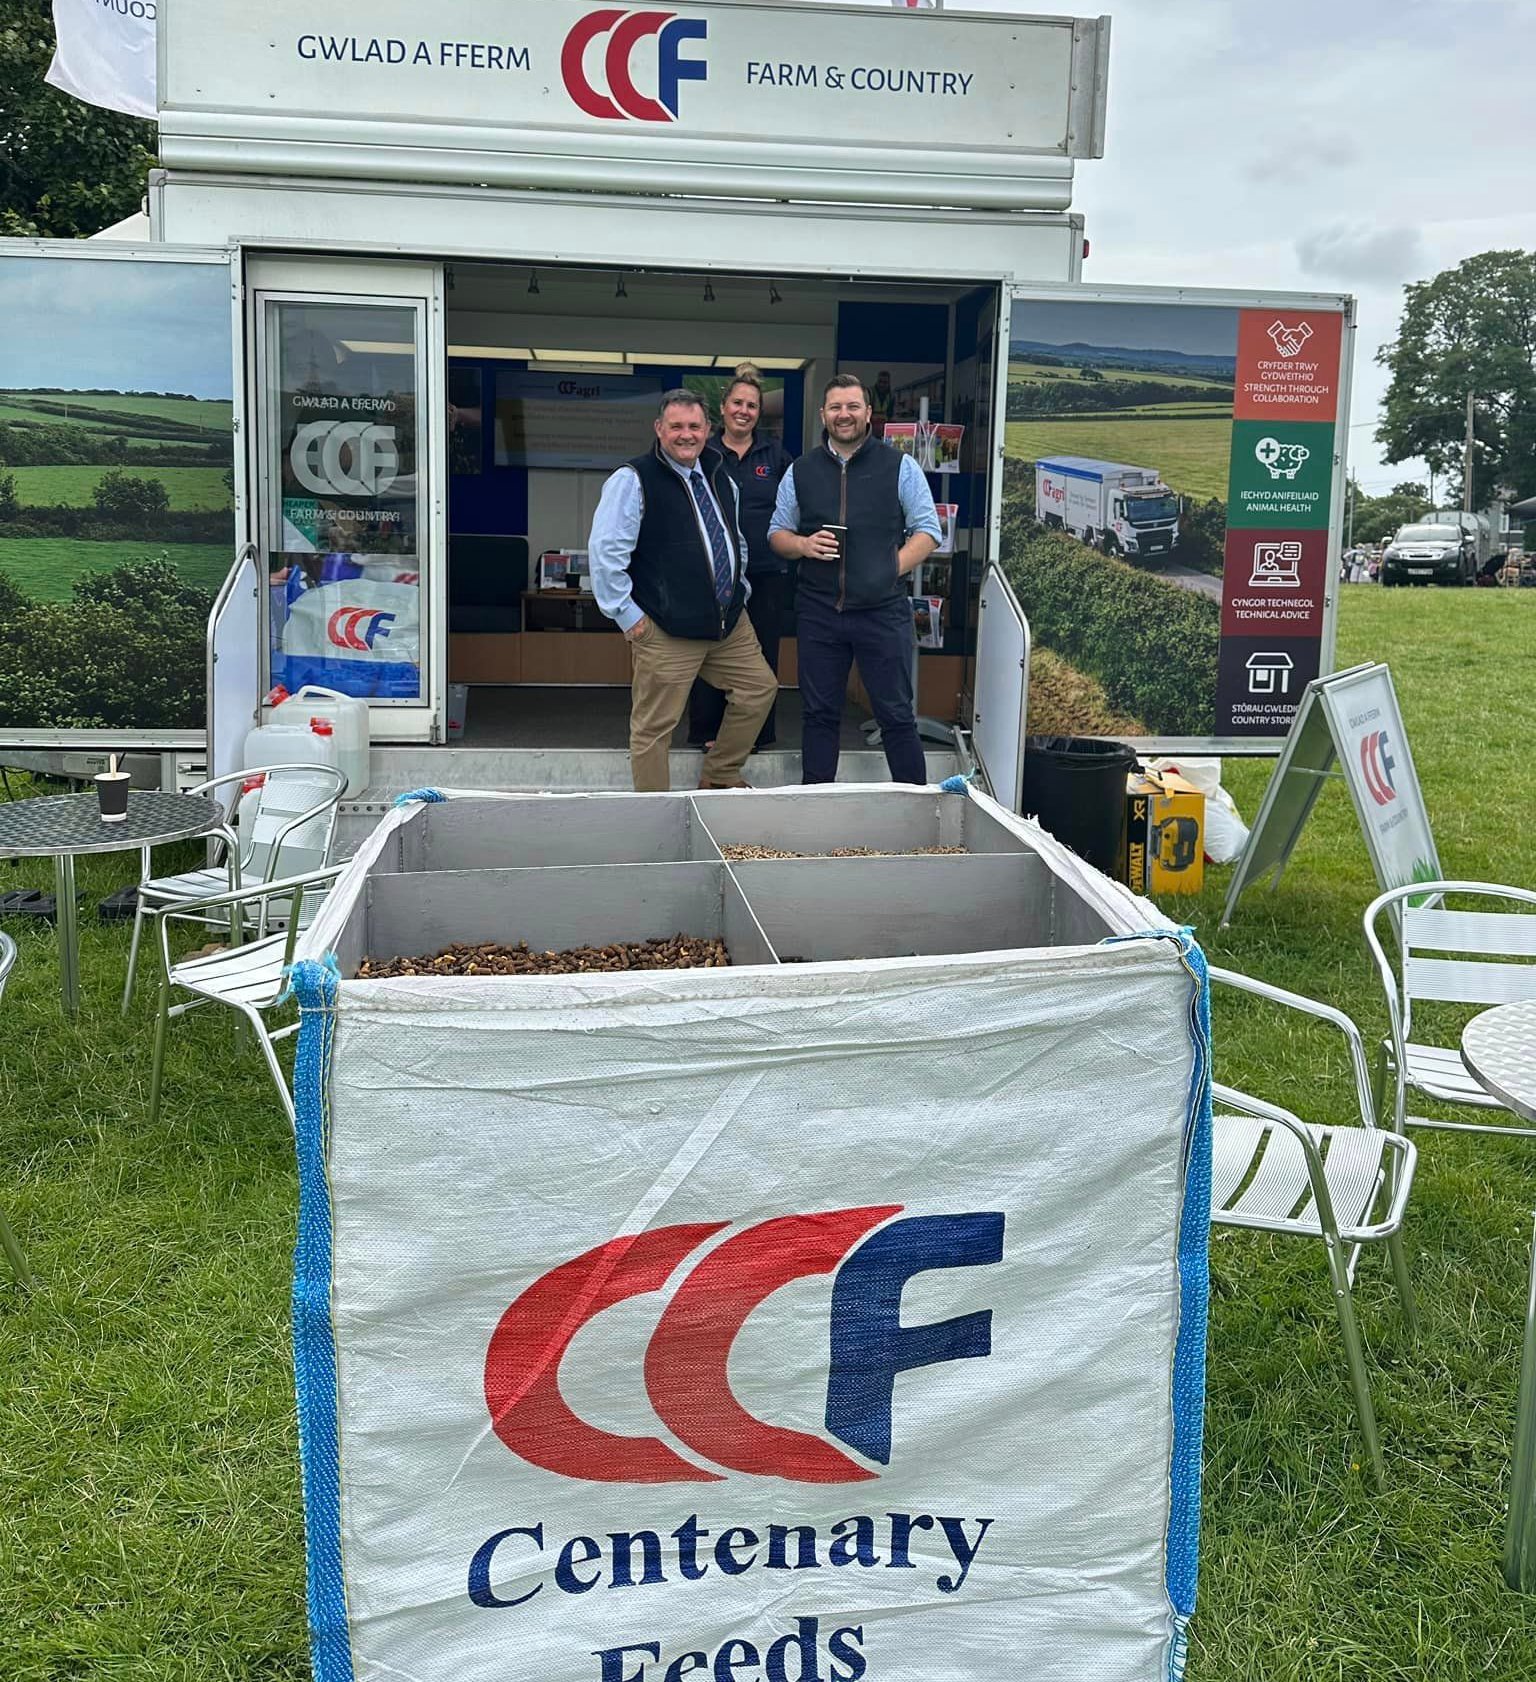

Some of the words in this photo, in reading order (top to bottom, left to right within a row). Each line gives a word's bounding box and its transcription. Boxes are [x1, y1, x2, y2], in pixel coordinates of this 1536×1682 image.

[297, 35, 406, 64] GWLAD
[412, 41, 432, 65] A
[440, 42, 531, 71] FFERM
[560, 9, 708, 122] CCF
[746, 62, 817, 88] FARM
[825, 65, 845, 90] &
[851, 67, 974, 96] COUNTRY
[1257, 361, 1294, 370] CRYFDER
[1295, 362, 1319, 371] TRWY
[1261, 371, 1314, 381] GYDWEITHIO
[1243, 383, 1286, 392] STRENGTH
[1288, 384, 1329, 394] THROUGH
[1253, 393, 1319, 404] COLLABORATION
[1240, 490, 1271, 500] IECHYD
[1246, 503, 1279, 512] ANIMAL
[1280, 503, 1312, 512] HEALTH
[1231, 598, 1266, 607] CYNGOR
[1267, 599, 1314, 608] TECHNEGOL
[1236, 610, 1280, 619] TECHNICAL
[1280, 610, 1310, 619] ADVICE
[327, 606, 396, 652] CCF
[1231, 715, 1270, 724] COUNTRY
[1133, 799, 1145, 820] XR
[483, 1203, 1006, 1485] CCF
[466, 1511, 996, 1609] Centenary
[590, 1615, 868, 1682] Feeds
